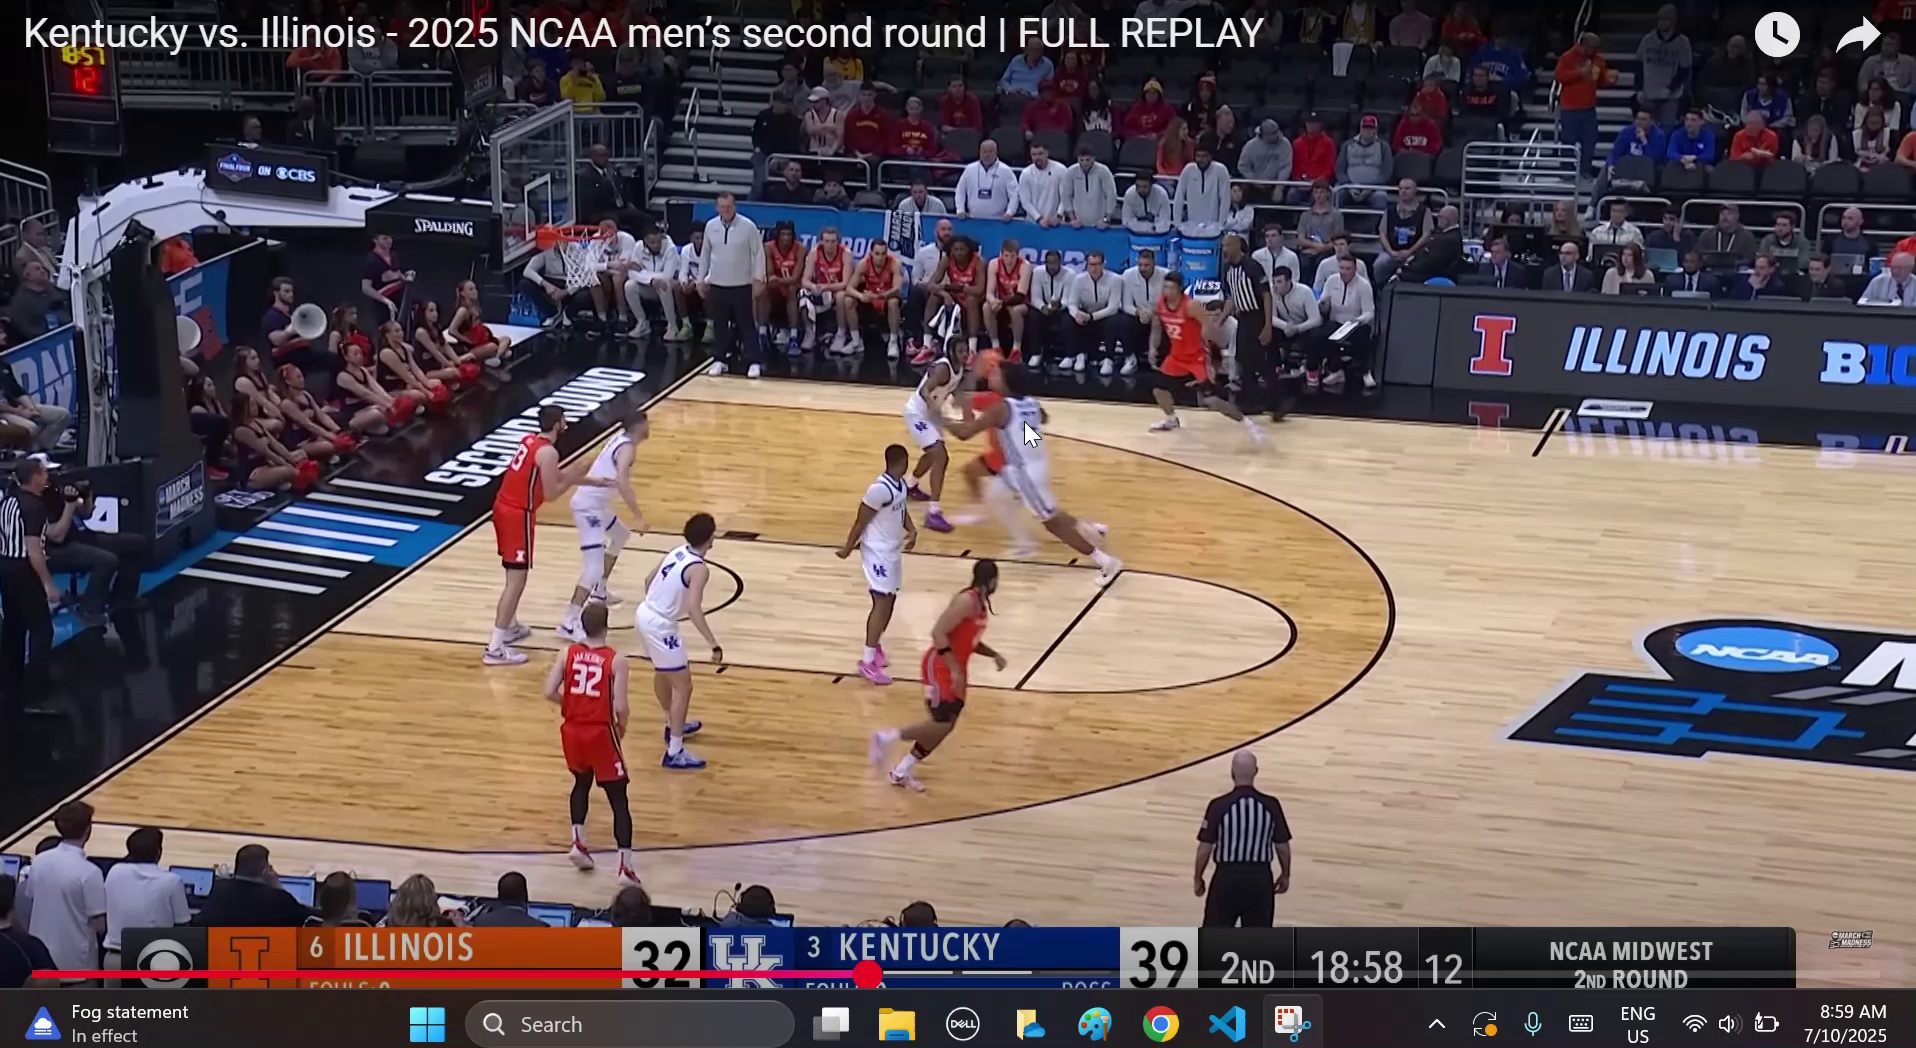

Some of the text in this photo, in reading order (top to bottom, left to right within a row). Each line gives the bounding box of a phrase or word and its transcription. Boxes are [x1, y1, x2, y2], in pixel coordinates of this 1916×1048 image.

[257, 165, 316, 183] ON CBS
[414, 217, 475, 238] SPALDING
[1563, 325, 1772, 382] ILLINOIS
[539, 366, 647, 423] ROUND
[424, 406, 542, 488] SECOND
[165, 475, 191, 504] MARCH
[169, 485, 204, 521] MADNESS
[1690, 643, 1829, 666] NCAA
[570, 661, 603, 697] 32
